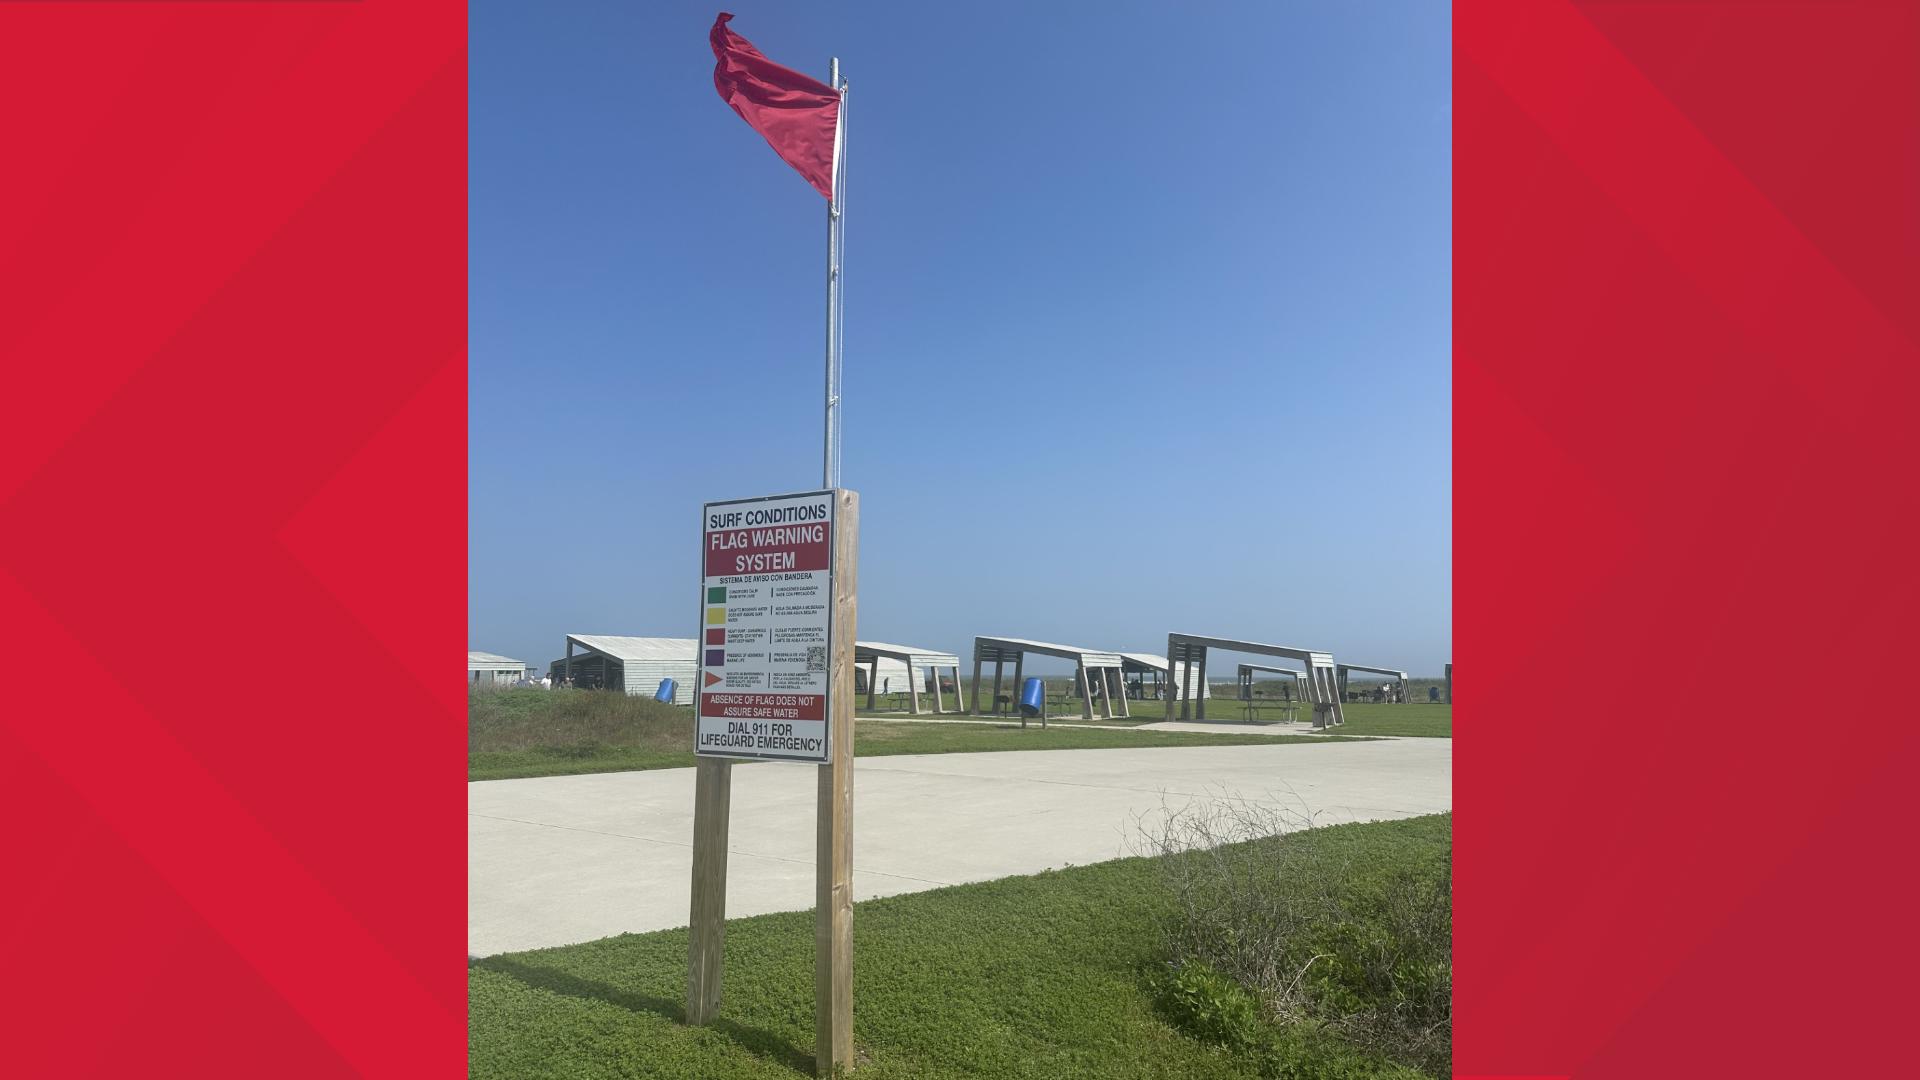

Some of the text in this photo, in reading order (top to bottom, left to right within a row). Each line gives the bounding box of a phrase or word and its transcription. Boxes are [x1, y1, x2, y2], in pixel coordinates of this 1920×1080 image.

[710, 504, 827, 529] SURF CONDITIONS
[711, 525, 824, 551] FLAG WARNING
[735, 551, 796, 572] SYSTEM
[719, 577, 743, 585] SISTEMA
[753, 575, 770, 583] AVISO
[770, 574, 783, 582] CON
[784, 572, 813, 581] BANDERA
[710, 694, 815, 707] ABSENCE OF FLAG DOES NOT
[723, 706, 799, 719] ASSURE SAFE WATER
[728, 721, 793, 736] DIAL 911 FOR
[701, 733, 823, 751] LIFEGUARD EMERGENCY
